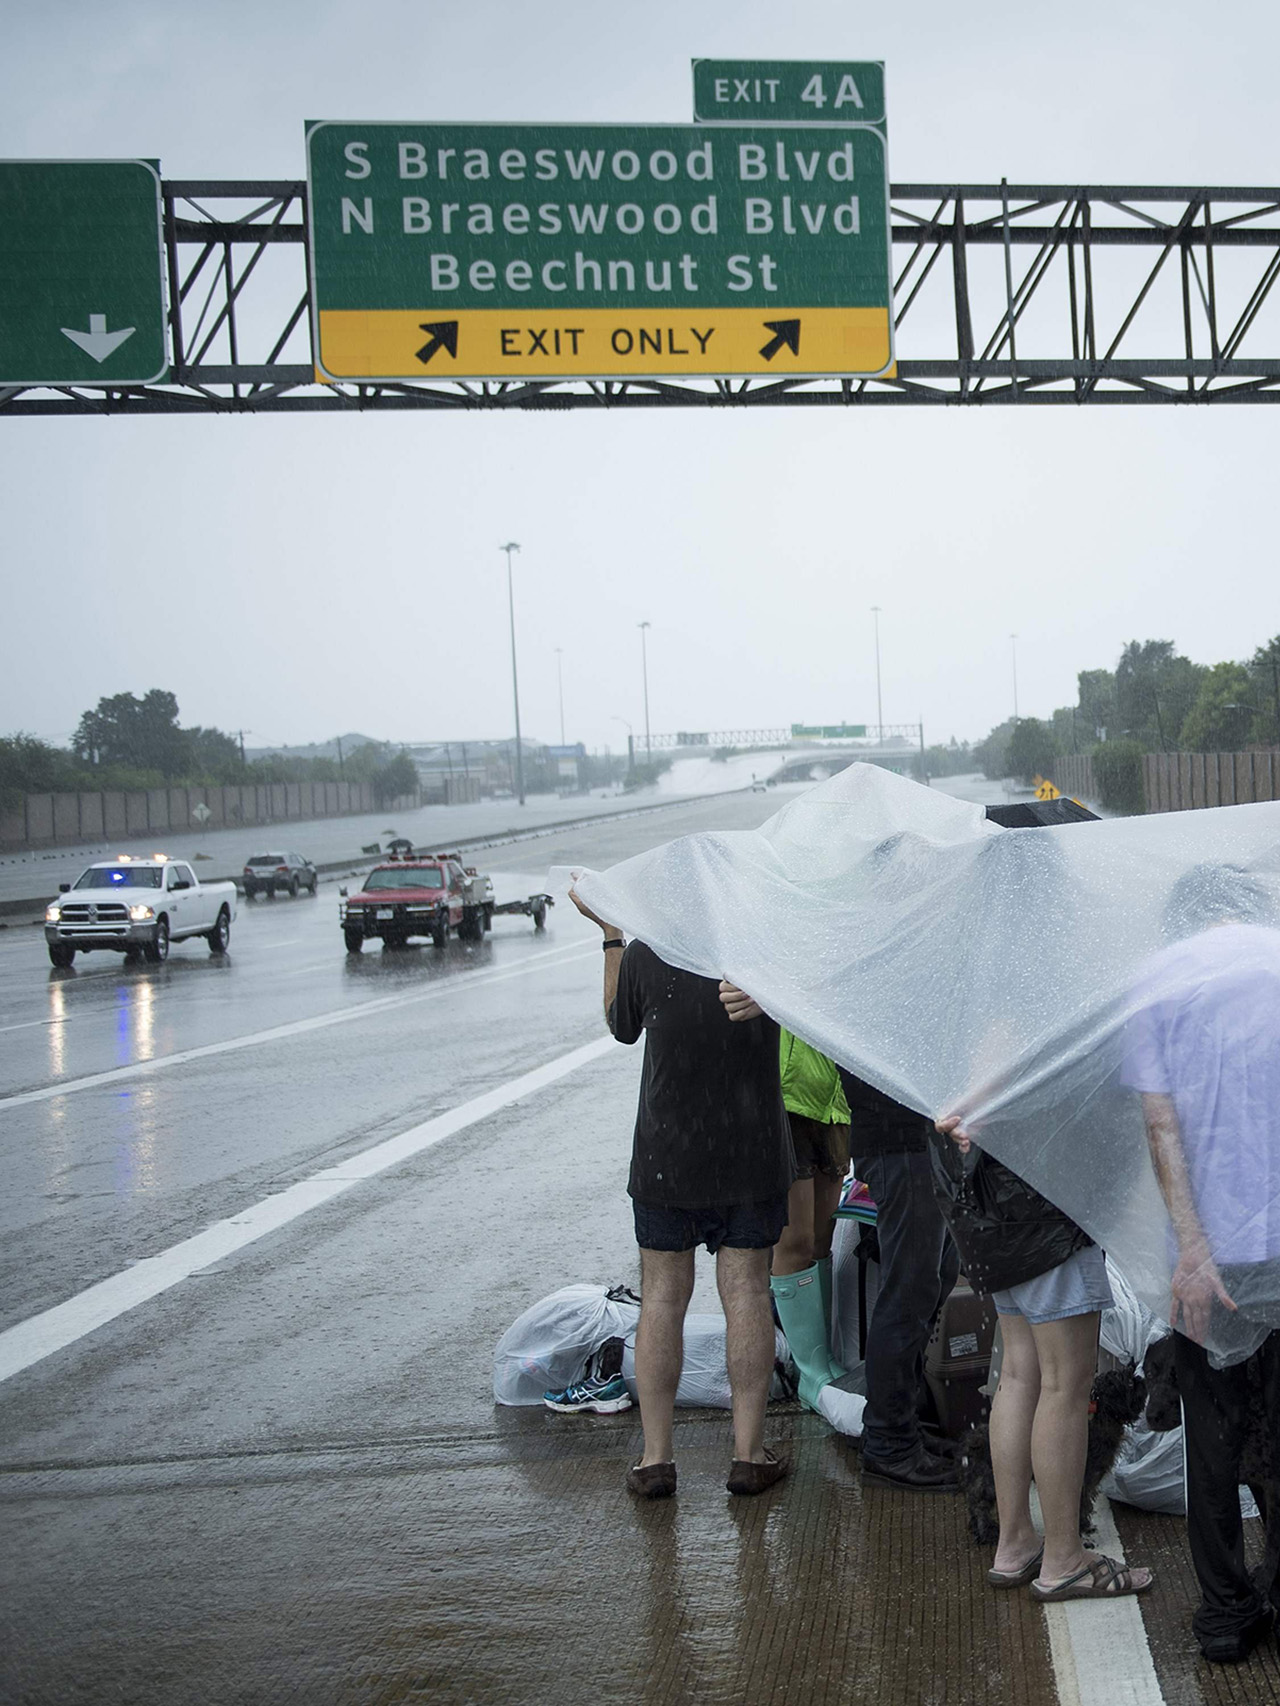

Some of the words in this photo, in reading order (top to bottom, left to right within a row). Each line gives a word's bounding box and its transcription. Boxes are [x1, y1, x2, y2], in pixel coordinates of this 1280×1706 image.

[714, 79, 780, 103] EXIT
[800, 74, 865, 109] 4A
[343, 141, 372, 180] S
[398, 141, 715, 182] Braeswood
[738, 141, 855, 182] Blvd
[341, 196, 375, 235] N
[402, 195, 718, 236] Braeswood
[744, 195, 861, 236] Blvd
[429, 252, 699, 292] Beechnut
[726, 253, 778, 292] St
[501, 328, 585, 356] EXIT
[611, 327, 716, 356] ONLY
